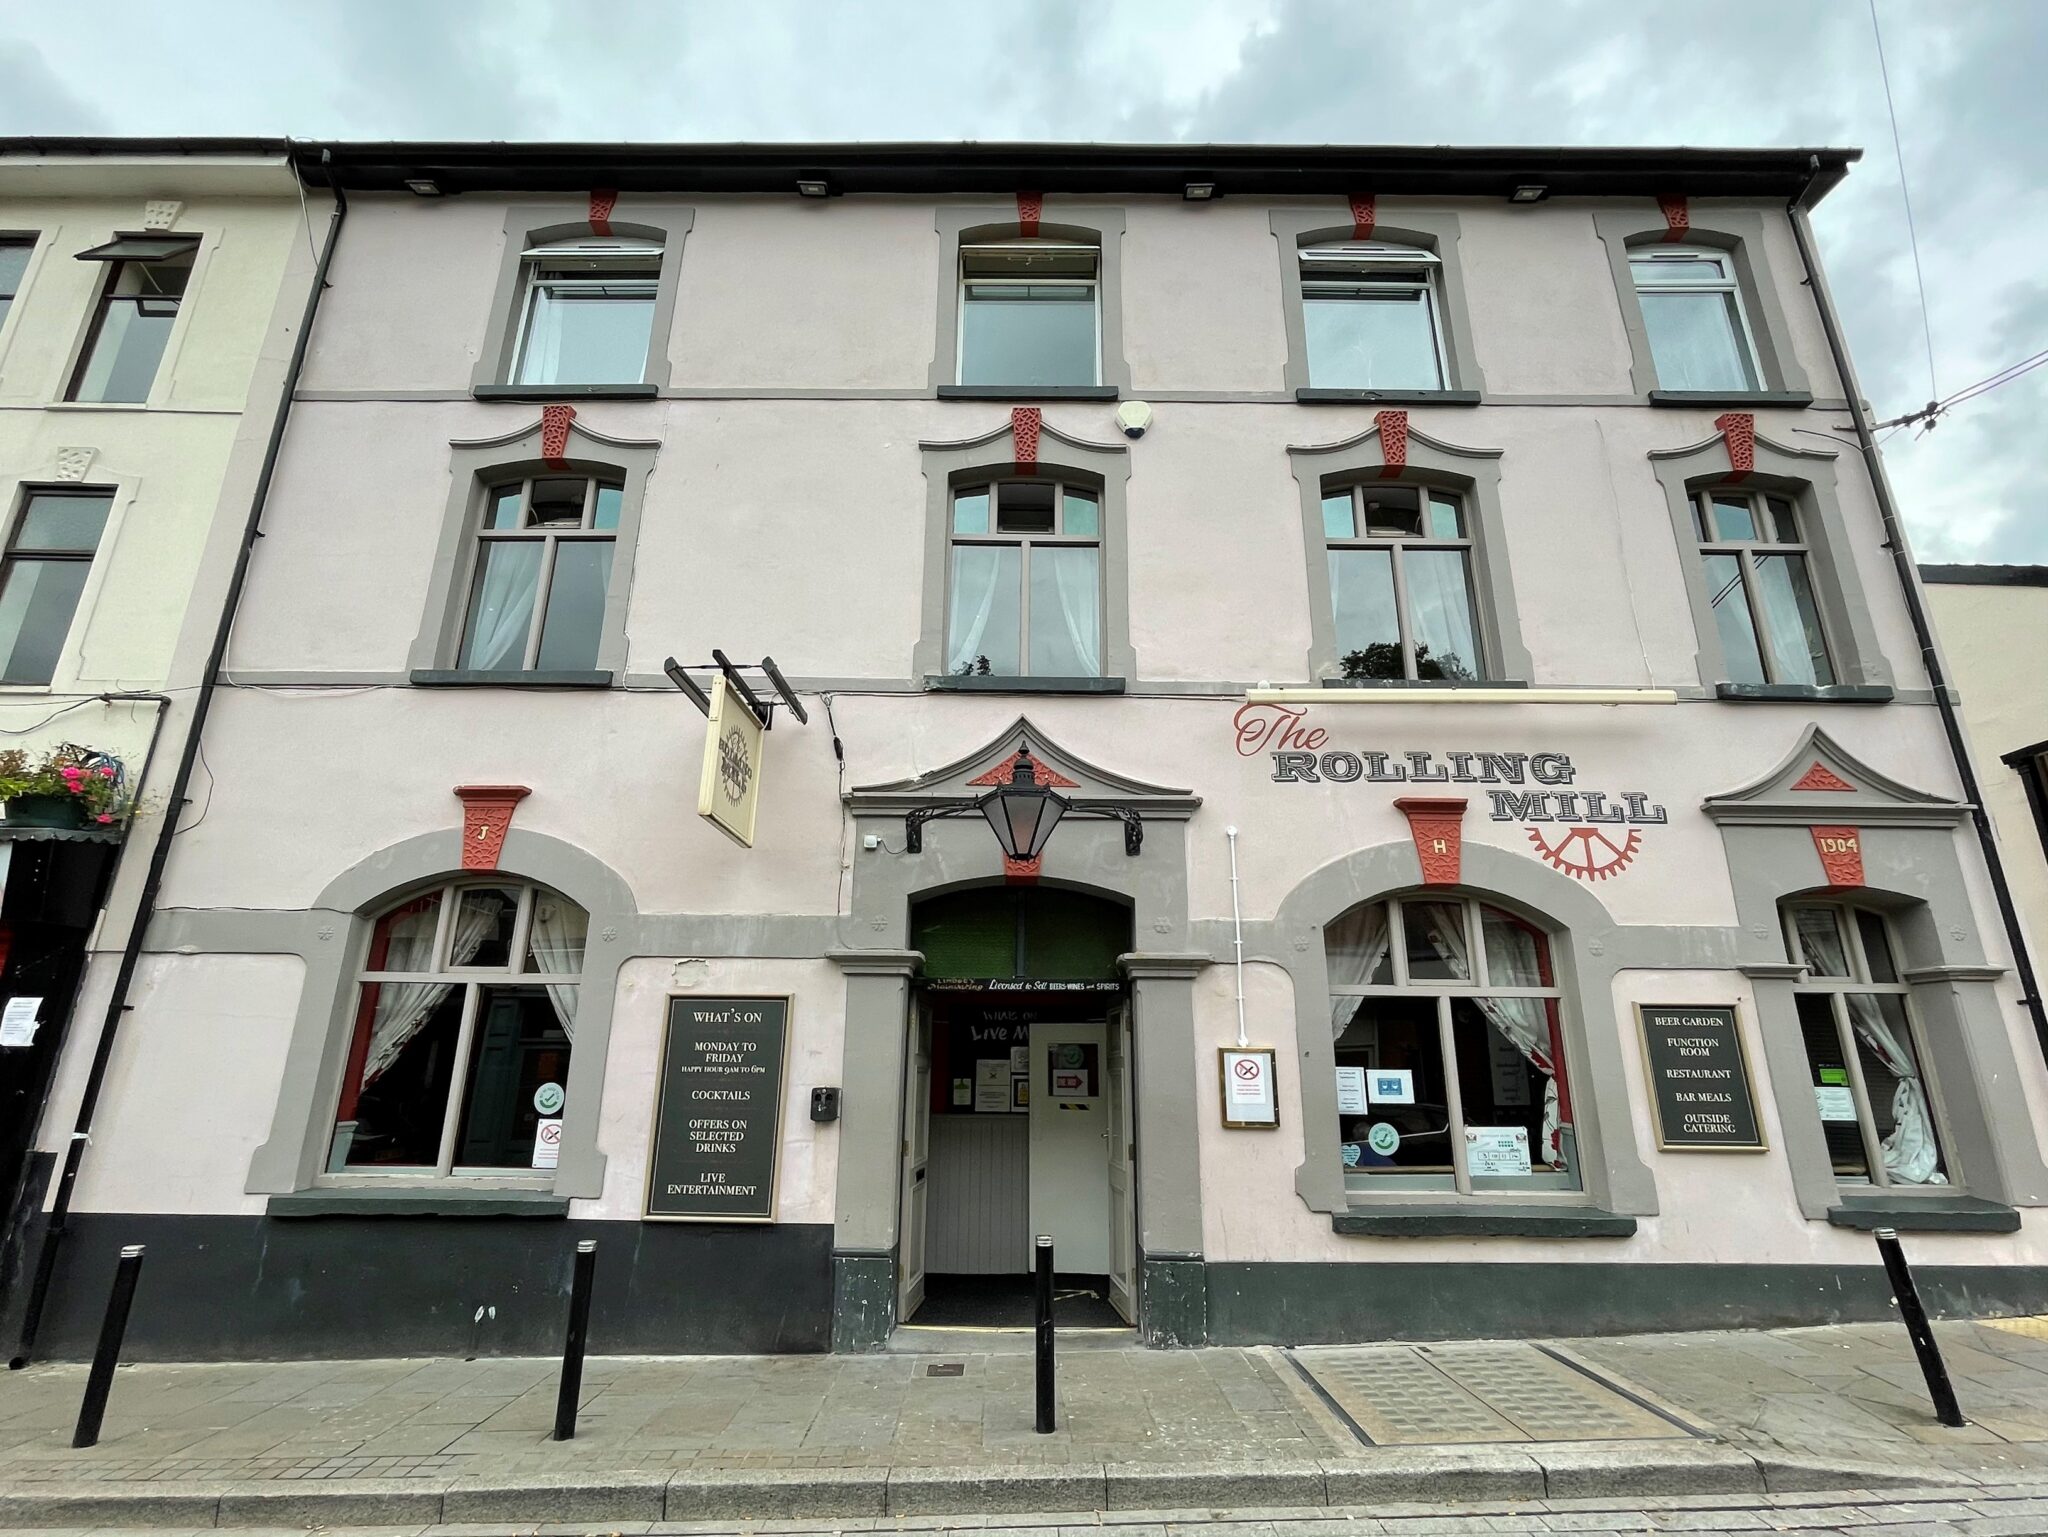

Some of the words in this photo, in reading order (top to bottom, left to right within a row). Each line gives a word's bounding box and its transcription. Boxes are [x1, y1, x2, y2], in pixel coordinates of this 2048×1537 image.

[1233, 703, 1329, 757] The
[1269, 750, 1577, 785] ROLLING
[1486, 789, 1668, 824] MILL
[477, 825, 490, 840] J
[1433, 839, 1447, 854] H
[1820, 838, 1858, 853] 1904
[988, 979, 1023, 990] Licensed
[1025, 982, 1033, 990] to
[1033, 980, 1048, 990] Sell
[1096, 982, 1120, 991] SPIRITS
[693, 1008, 741, 1023] WHAT'S
[744, 1012, 762, 1023] ON
[1654, 1016, 1681, 1026] BEER
[1682, 1017, 1724, 1027] GARDEN
[694, 1042, 740, 1051] MONDAY
[742, 1042, 757, 1051] TO
[1667, 1037, 1719, 1047] FUNCTION
[705, 1053, 744, 1063] FRIDAY
[1680, 1048, 1710, 1057] ROOM
[724, 1066, 739, 1075] 9AM
[751, 1065, 766, 1073] 6PM
[1666, 1069, 1732, 1079] RESTAURANT
[691, 1090, 751, 1100] COCKTAILS
[1675, 1092, 1697, 1102] BAR
[1698, 1092, 1732, 1102] MEALS
[1684, 1113, 1731, 1124] OUTSIDE
[689, 1119, 729, 1130] OFFERS
[731, 1119, 748, 1130] ON
[1683, 1123, 1736, 1134] CATERING
[689, 1131, 744, 1142] SELECTED
[695, 1143, 736, 1153] DRINKS
[700, 1173, 726, 1183] LIVE
[667, 1185, 757, 1196] ENTERTAINMENT
